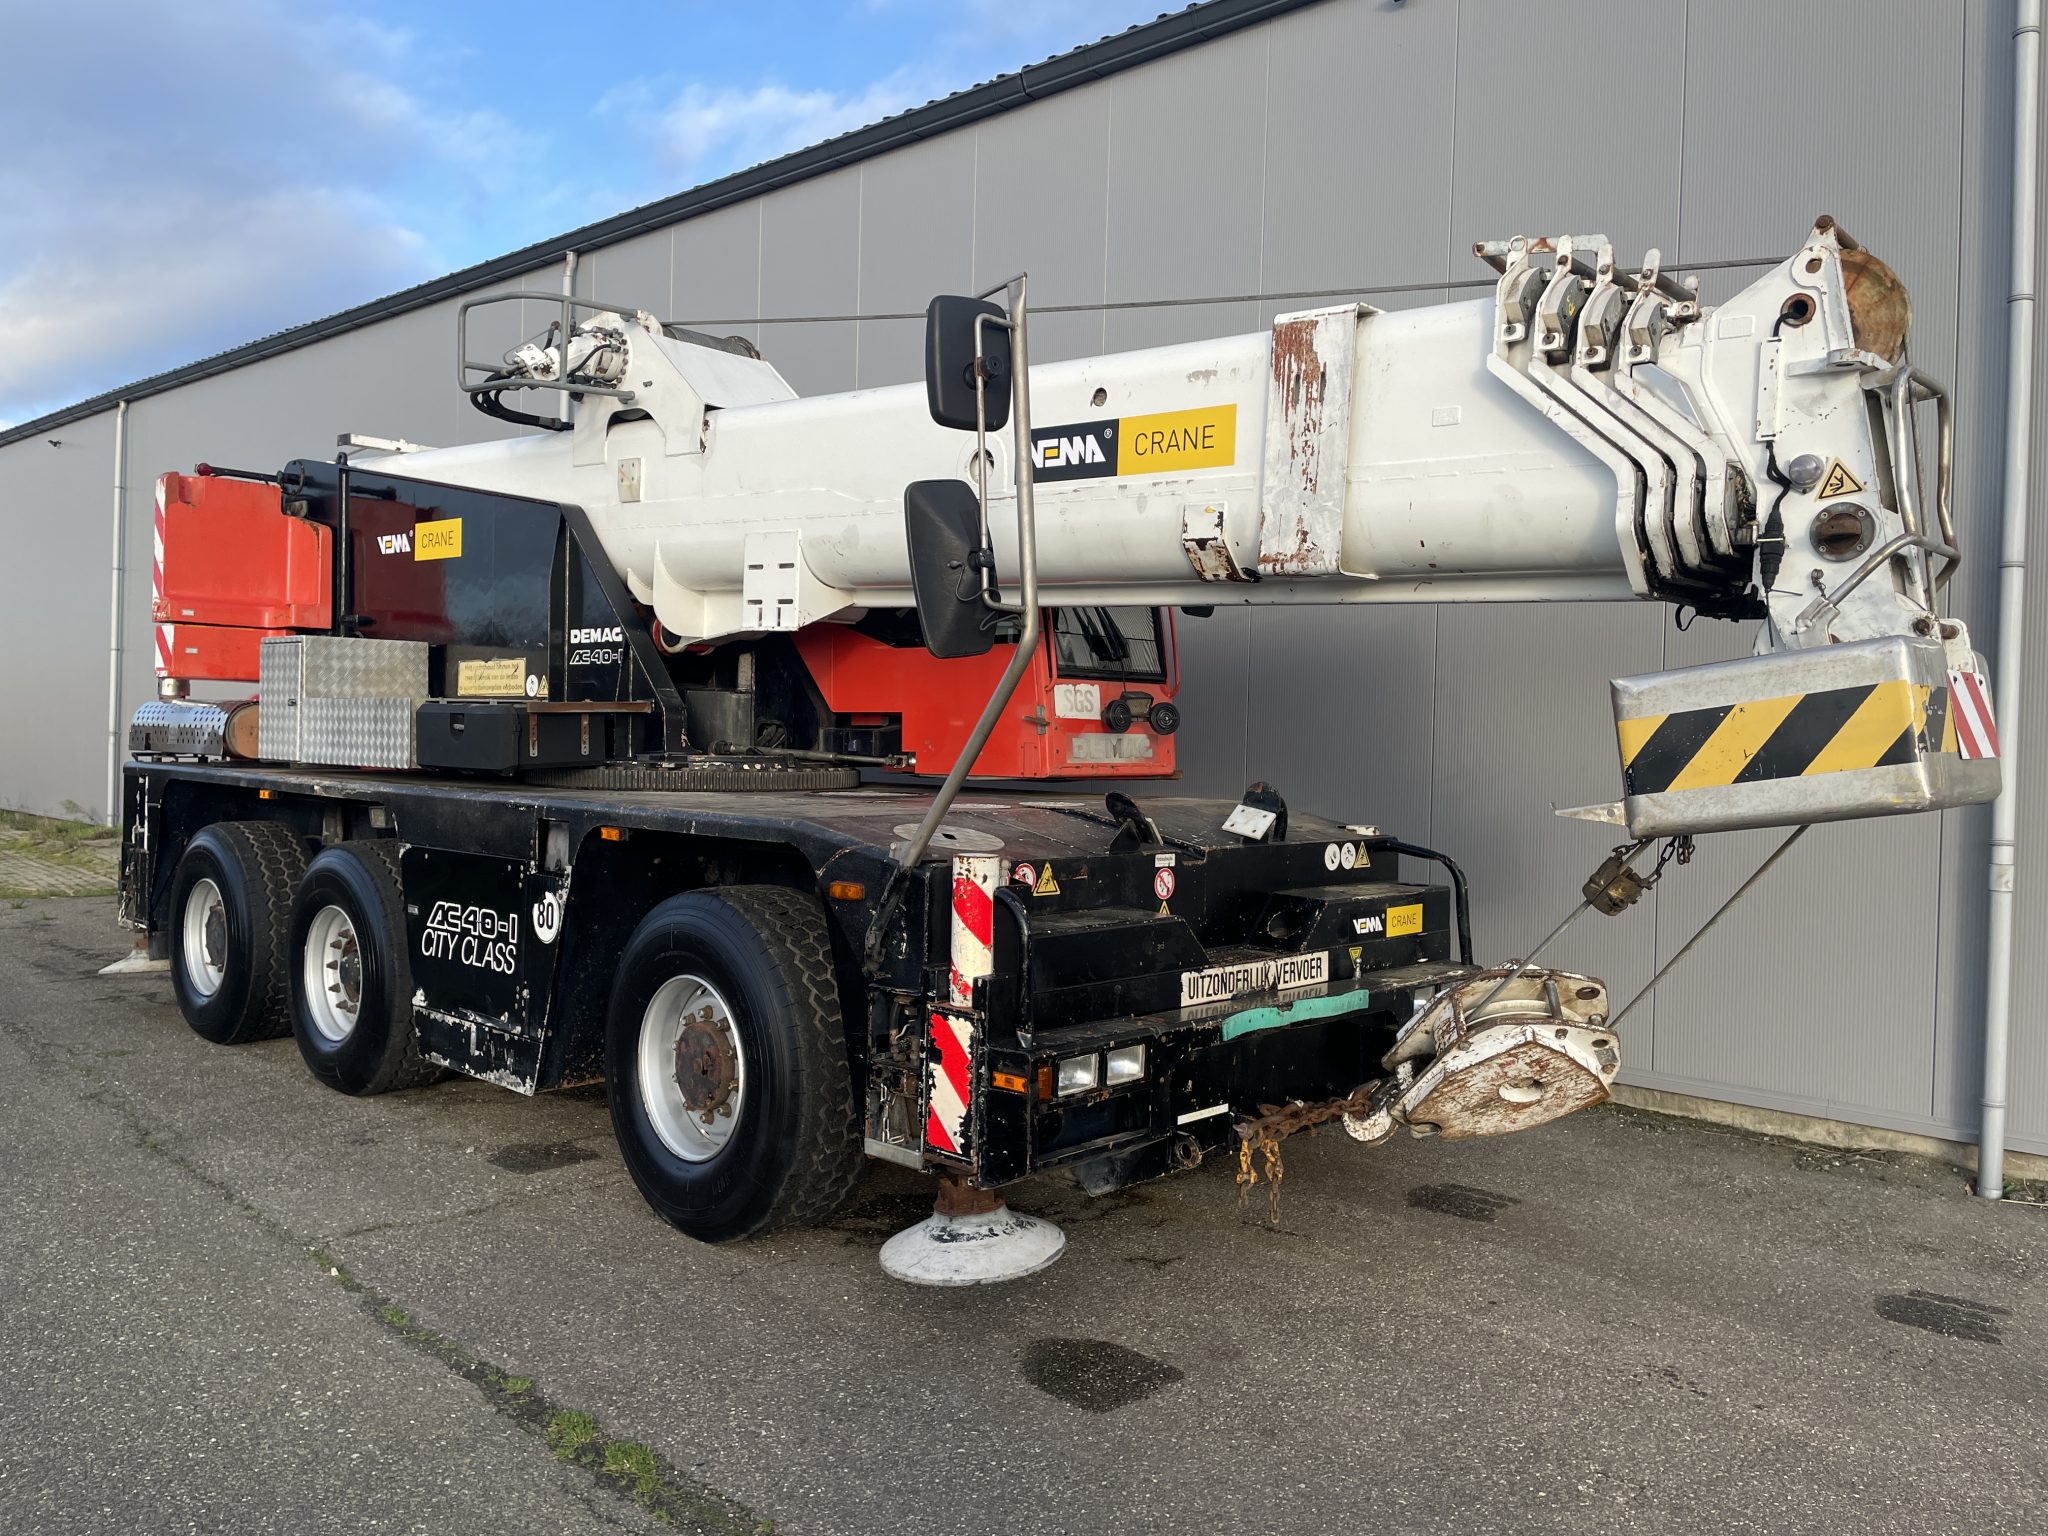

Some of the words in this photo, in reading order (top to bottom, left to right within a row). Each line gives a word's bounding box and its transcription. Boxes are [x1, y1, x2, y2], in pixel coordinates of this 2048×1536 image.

[1134, 424, 1216, 456] CRANE
[377, 533, 411, 555] VEMA
[421, 530, 454, 549] CRANE
[570, 626, 623, 644] DEMAG
[1063, 689, 1094, 712] SGS
[537, 901, 554, 930] 80
[1352, 916, 1384, 935] VEMA
[1391, 912, 1417, 928] CRANE
[421, 928, 459, 960] CITY
[461, 936, 517, 975] CLASS
[1275, 956, 1323, 985] VERVOER
